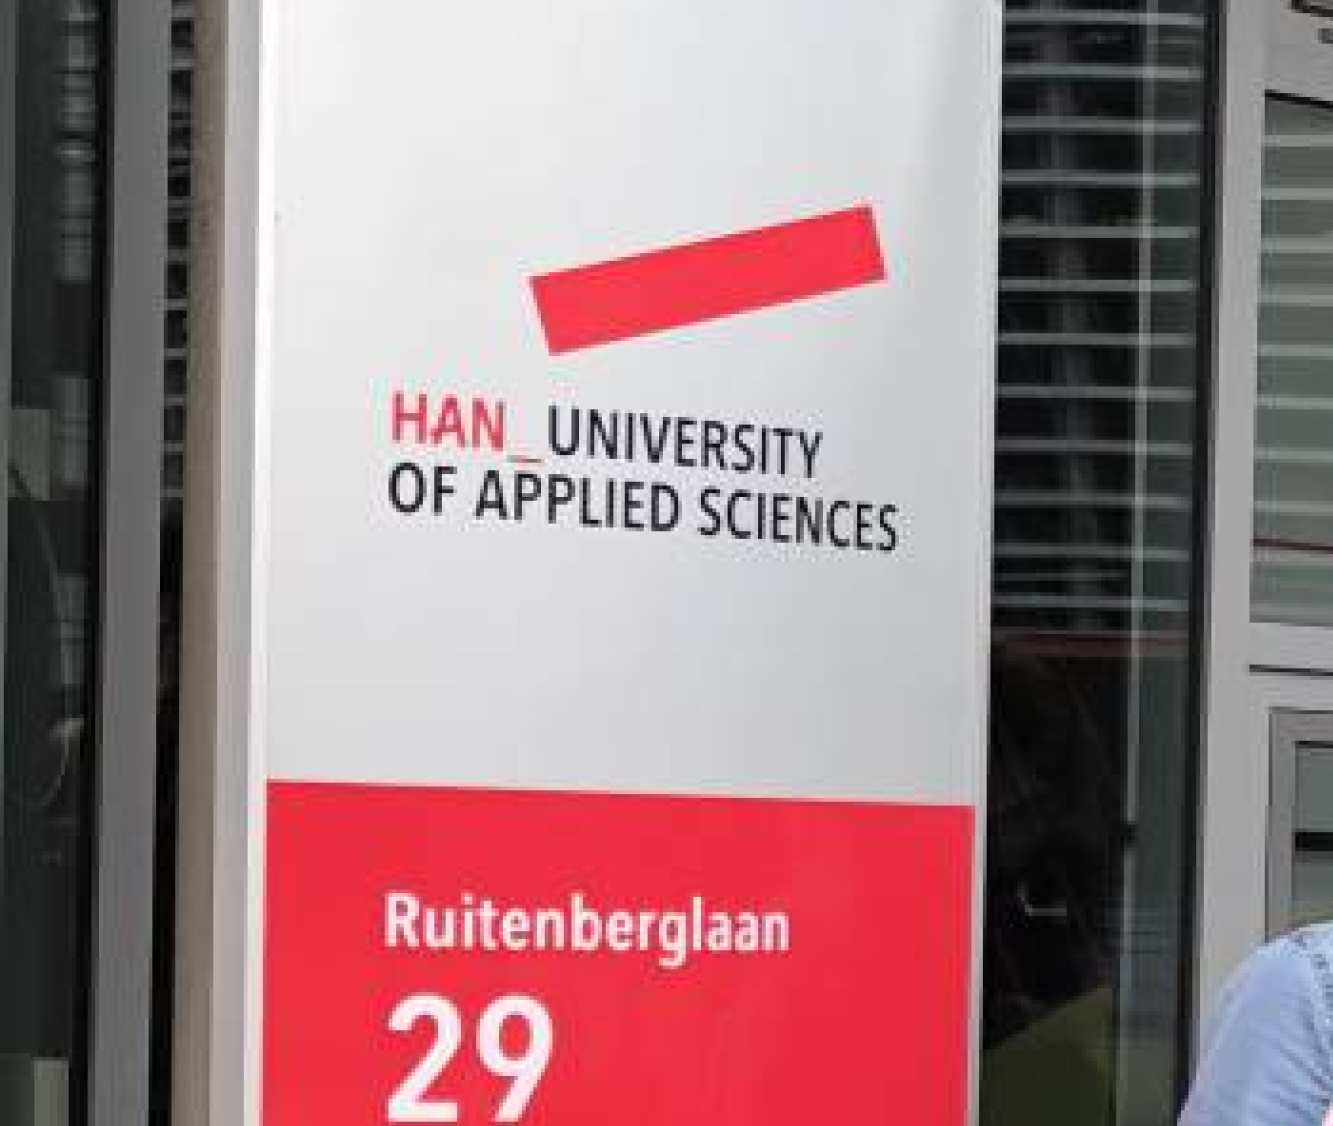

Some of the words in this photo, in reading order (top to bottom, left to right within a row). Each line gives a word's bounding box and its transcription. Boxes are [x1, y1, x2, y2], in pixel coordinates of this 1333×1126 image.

[388, 461, 458, 515] OF
[475, 468, 681, 532] APPLIED
[697, 485, 898, 552] SCIENCES
[384, 891, 790, 970] Ruitenberglaan
[386, 993, 554, 1123] 29
